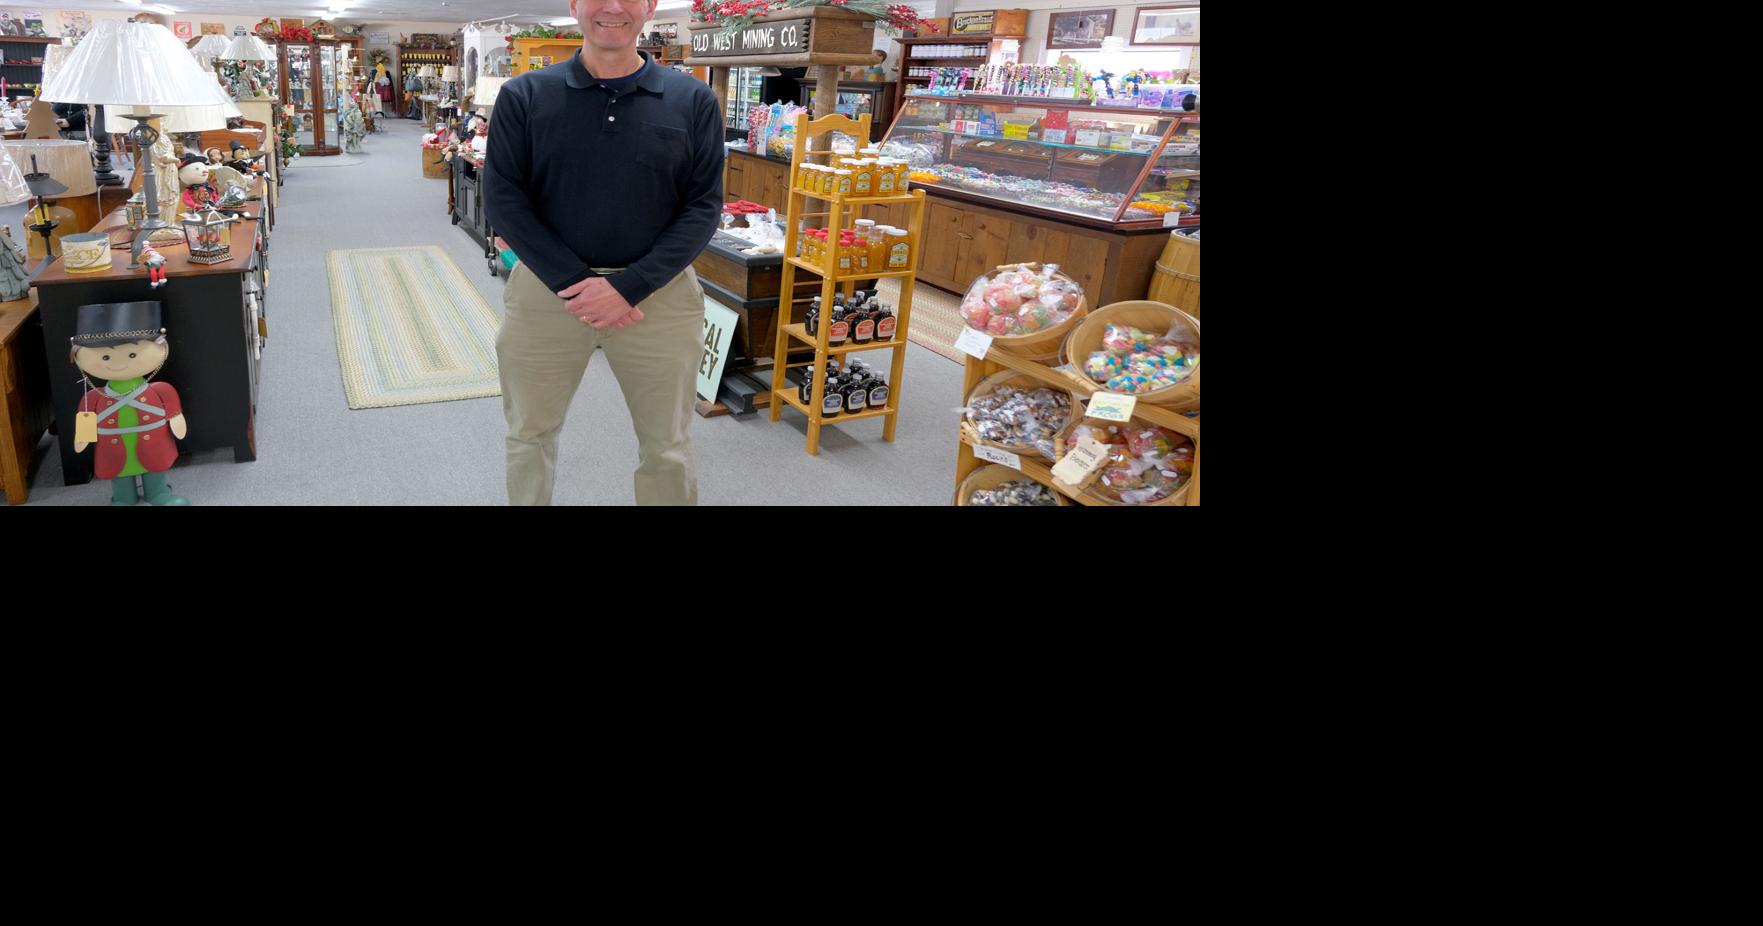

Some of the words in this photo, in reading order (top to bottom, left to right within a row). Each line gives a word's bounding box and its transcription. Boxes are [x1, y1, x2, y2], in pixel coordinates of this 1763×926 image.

[693, 33, 709, 52] OLD
[713, 31, 738, 51] WEST
[742, 27, 775, 49] MINING
[780, 25, 798, 47] CO.
